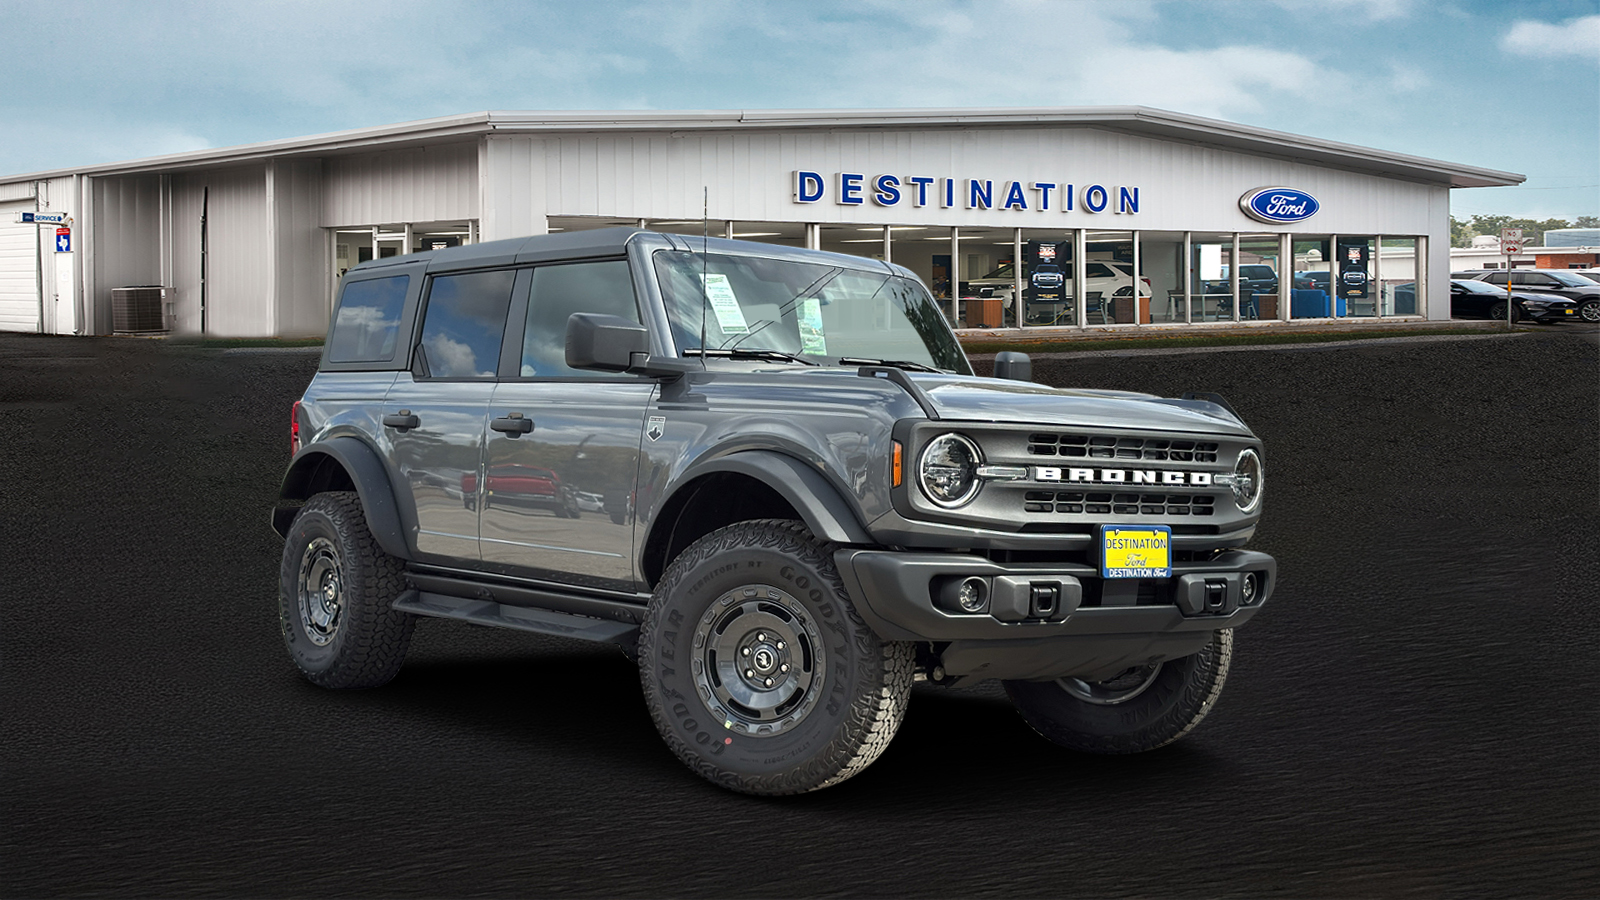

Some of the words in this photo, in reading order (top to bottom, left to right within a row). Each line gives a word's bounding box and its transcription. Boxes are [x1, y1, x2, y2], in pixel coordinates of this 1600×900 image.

[792, 170, 1140, 215] DESTINATION
[1266, 194, 1307, 216] Ford
[1035, 466, 1212, 485] BRONCO
[1105, 538, 1167, 550] DESTINATION
[1125, 553, 1148, 567] Ford
[687, 562, 740, 597] TERRITORY
[748, 560, 764, 568] RT
[1109, 568, 1152, 577] DESTINATION
[1153, 568, 1168, 577] Ford
